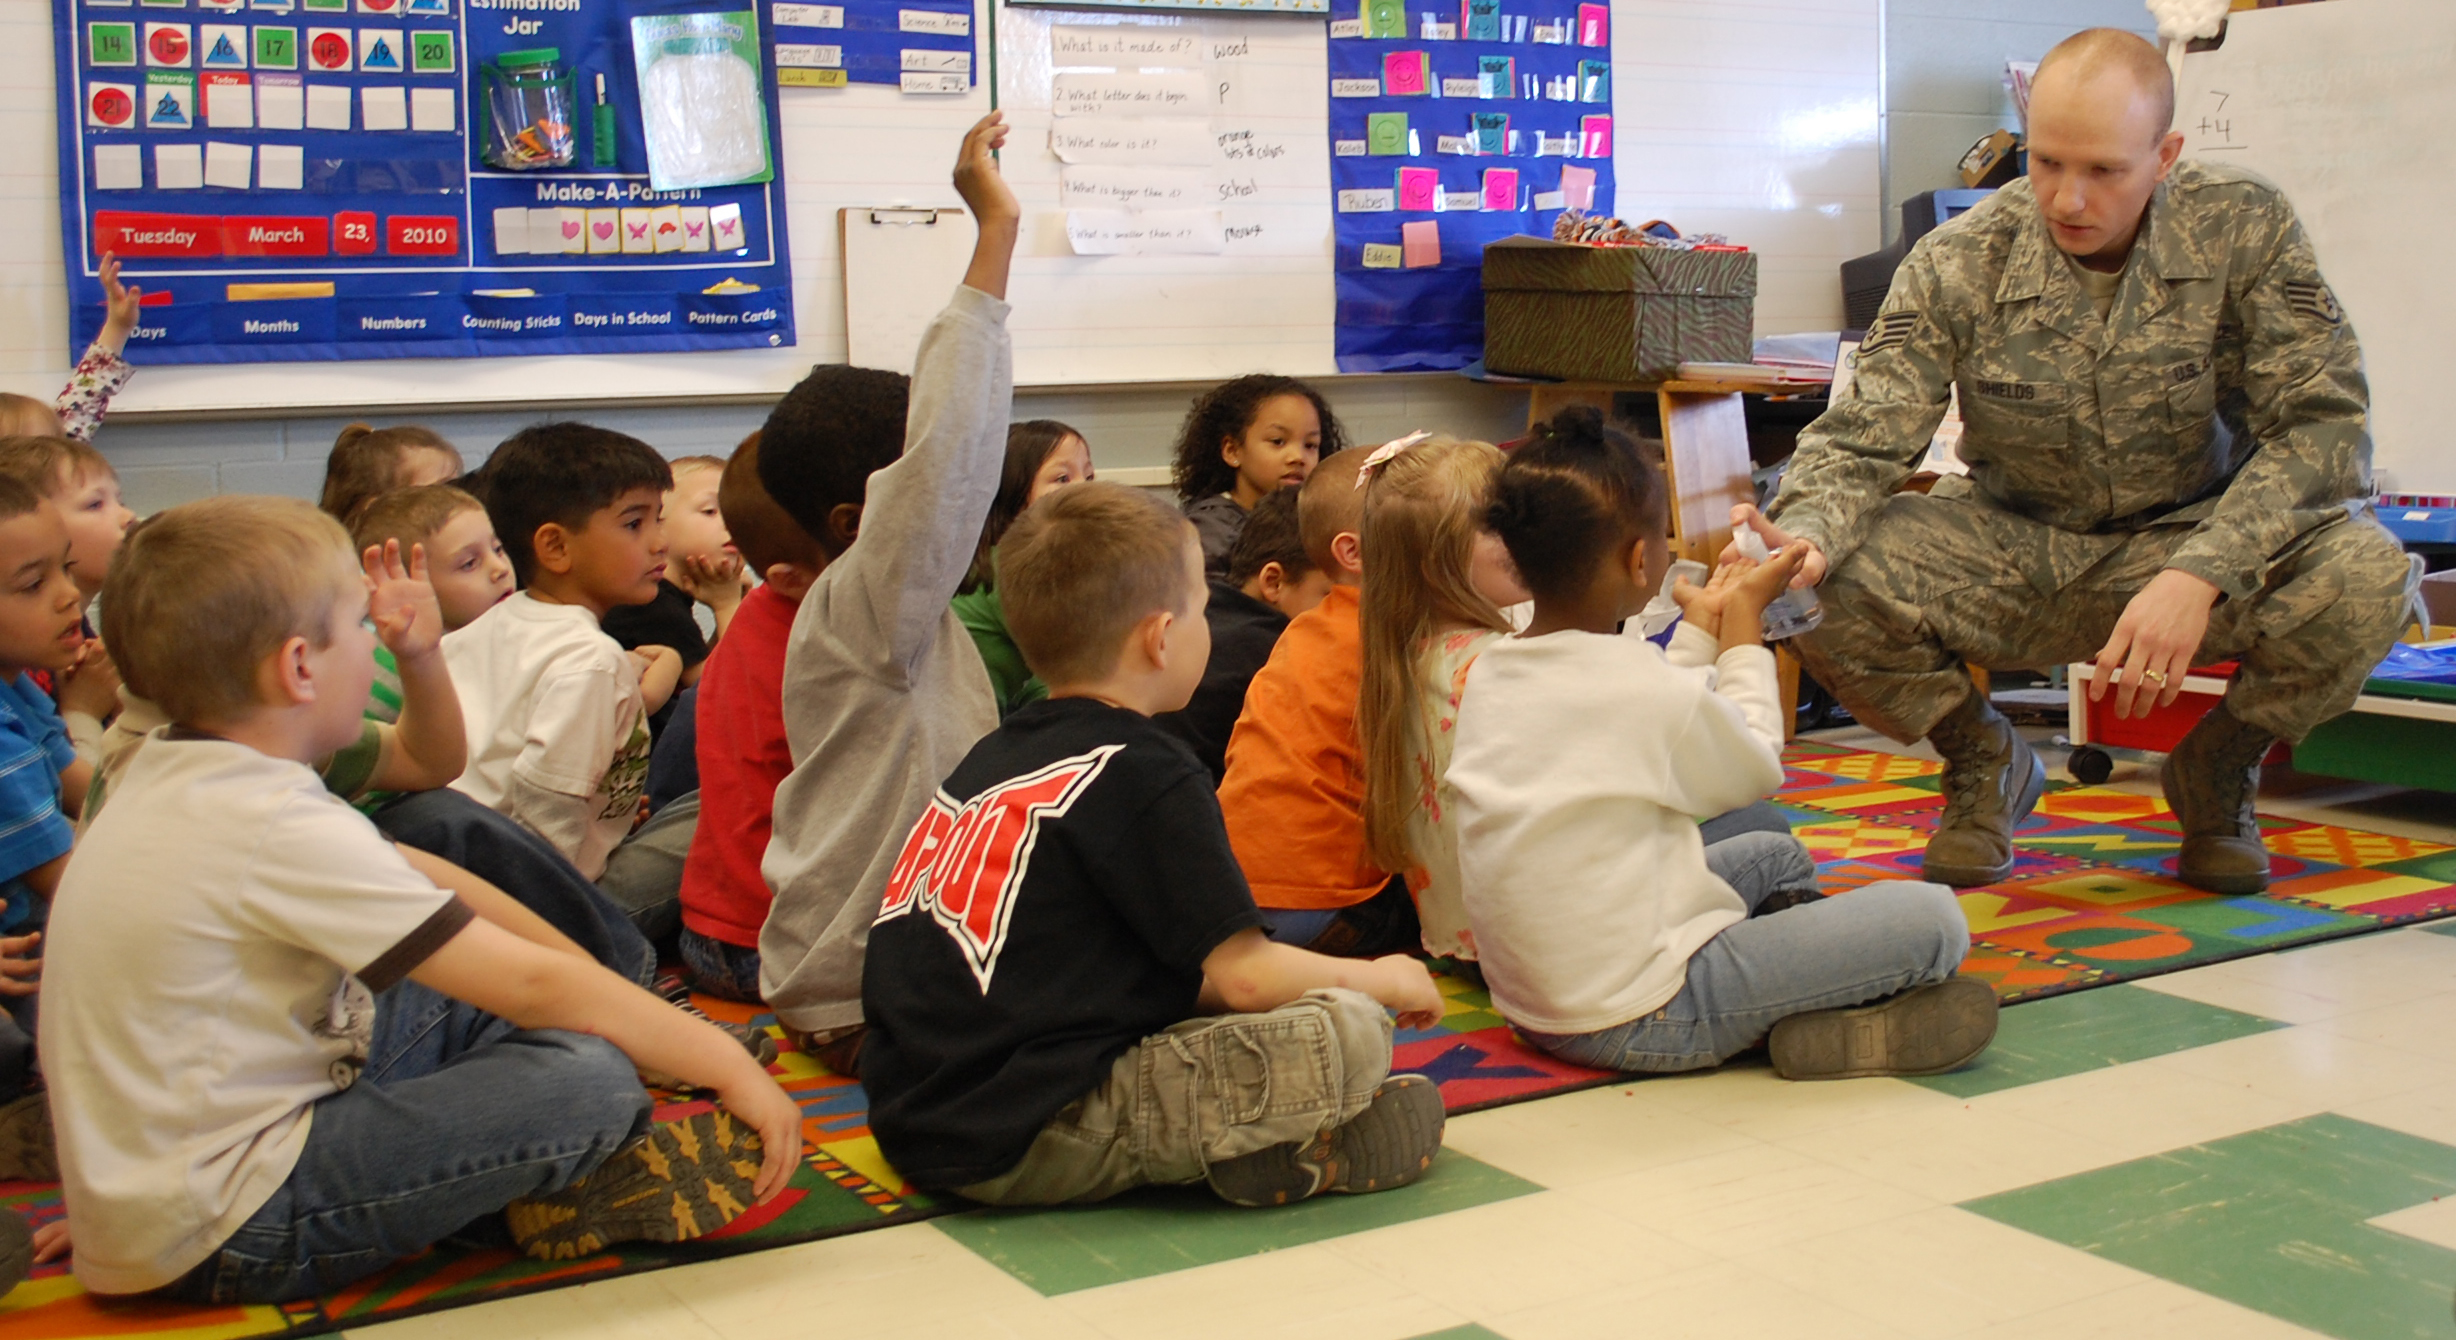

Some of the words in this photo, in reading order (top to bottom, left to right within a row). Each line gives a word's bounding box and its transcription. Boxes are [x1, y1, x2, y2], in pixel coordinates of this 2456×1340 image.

[503, 15, 544, 35] Jar
[102, 36, 122, 54] 14
[158, 37, 178, 55] 15
[215, 38, 234, 55] 16
[266, 40, 285, 56] 17
[319, 41, 338, 58] 18
[372, 43, 390, 60] 19
[421, 44, 444, 61] 20
[1060, 36, 1093, 53] What
[1113, 37, 1125, 53] it
[1129, 37, 1165, 54] made
[1213, 36, 1249, 60] wood
[905, 55, 928, 67] Art
[148, 73, 194, 87] Yesterday
[211, 75, 239, 86] Today
[257, 77, 301, 86] Tomorrow
[1068, 88, 1097, 101] What
[2209, 89, 2230, 113] 7
[103, 99, 122, 116] 21
[157, 99, 180, 117] 22
[1067, 137, 1095, 149] What
[1072, 181, 1096, 194] What
[1343, 193, 1388, 210] Ruben
[120, 227, 197, 247] Tuesday
[248, 226, 304, 243] March
[344, 223, 370, 243] 23,
[402, 228, 447, 244] 2010
[1365, 247, 1392, 262] Eddie
[361, 316, 427, 331] Numbers
[462, 314, 522, 331] Counting
[526, 315, 561, 329] Sticks
[574, 312, 609, 327] Days
[611, 312, 625, 325] in
[627, 311, 672, 325] School
[688, 311, 738, 324] Pattern
[741, 307, 777, 323] Cards
[130, 325, 167, 341] Days
[244, 320, 299, 334] Months
[1977, 380, 2035, 400] SHIELDS
[871, 744, 1127, 996] APOUT
